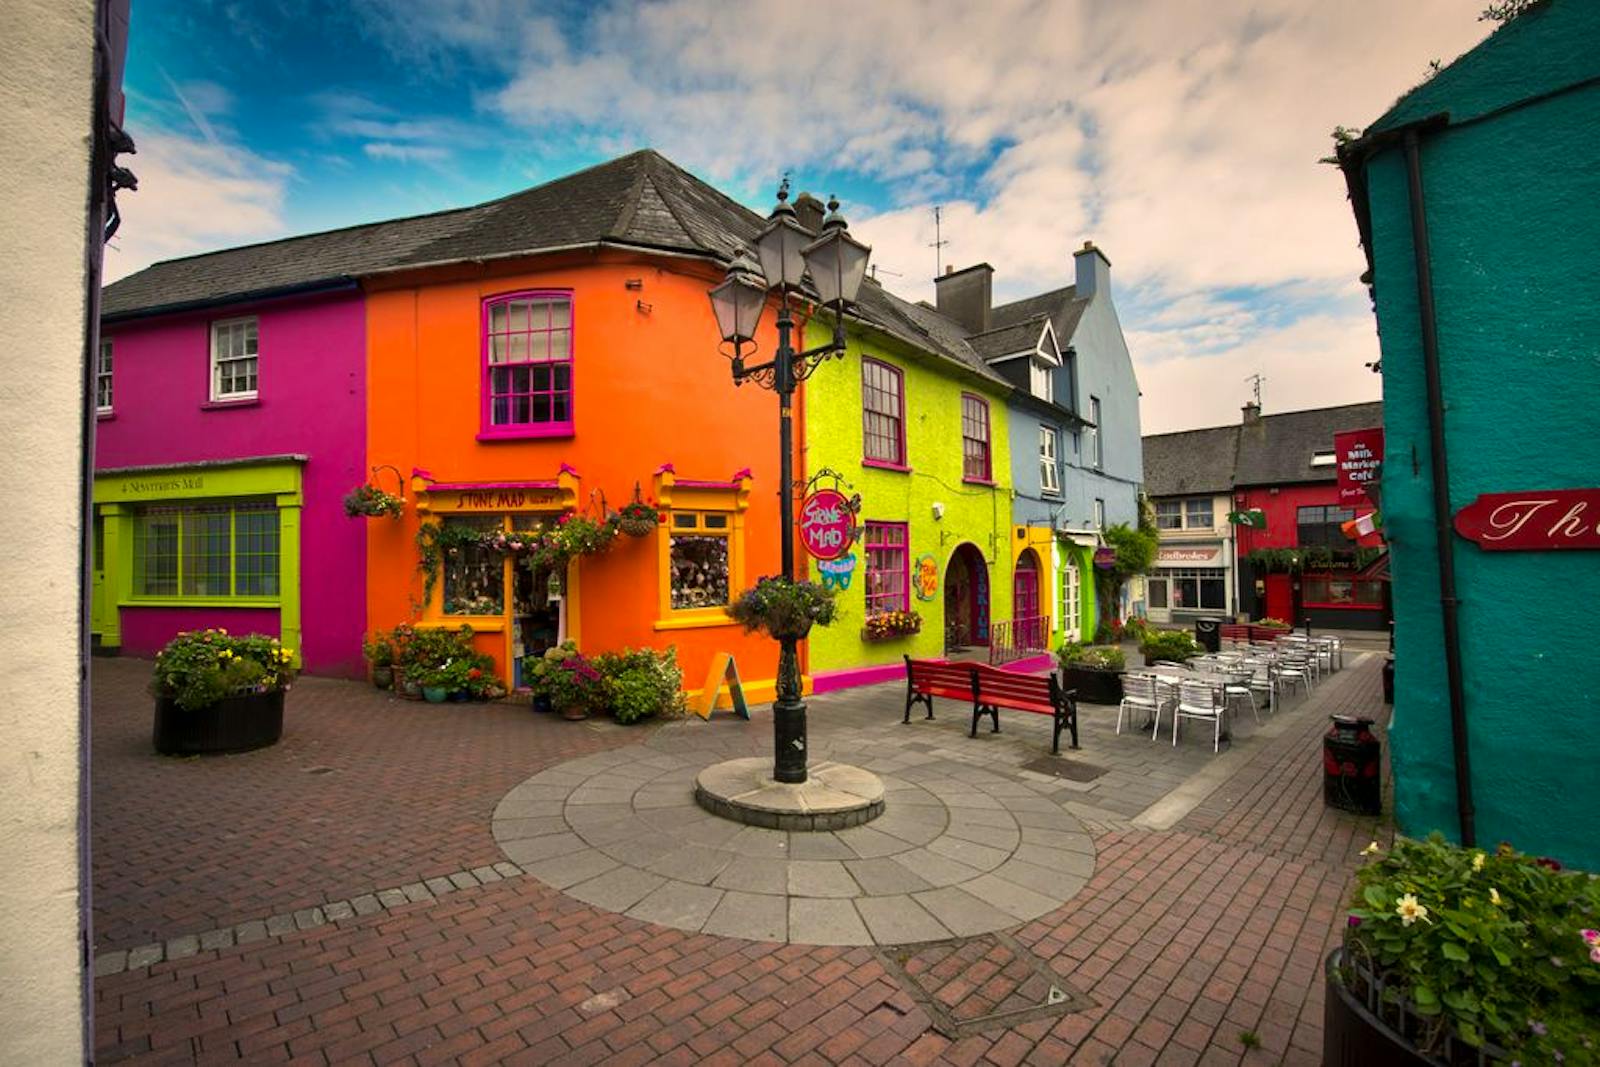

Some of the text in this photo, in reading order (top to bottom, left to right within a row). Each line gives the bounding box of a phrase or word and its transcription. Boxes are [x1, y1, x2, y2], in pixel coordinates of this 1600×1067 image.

[1348, 449, 1373, 460] Milk
[457, 493, 494, 509] STONE
[497, 492, 525, 508] MAD
[1482, 499, 1600, 540] Th
[808, 528, 843, 549] MAD
